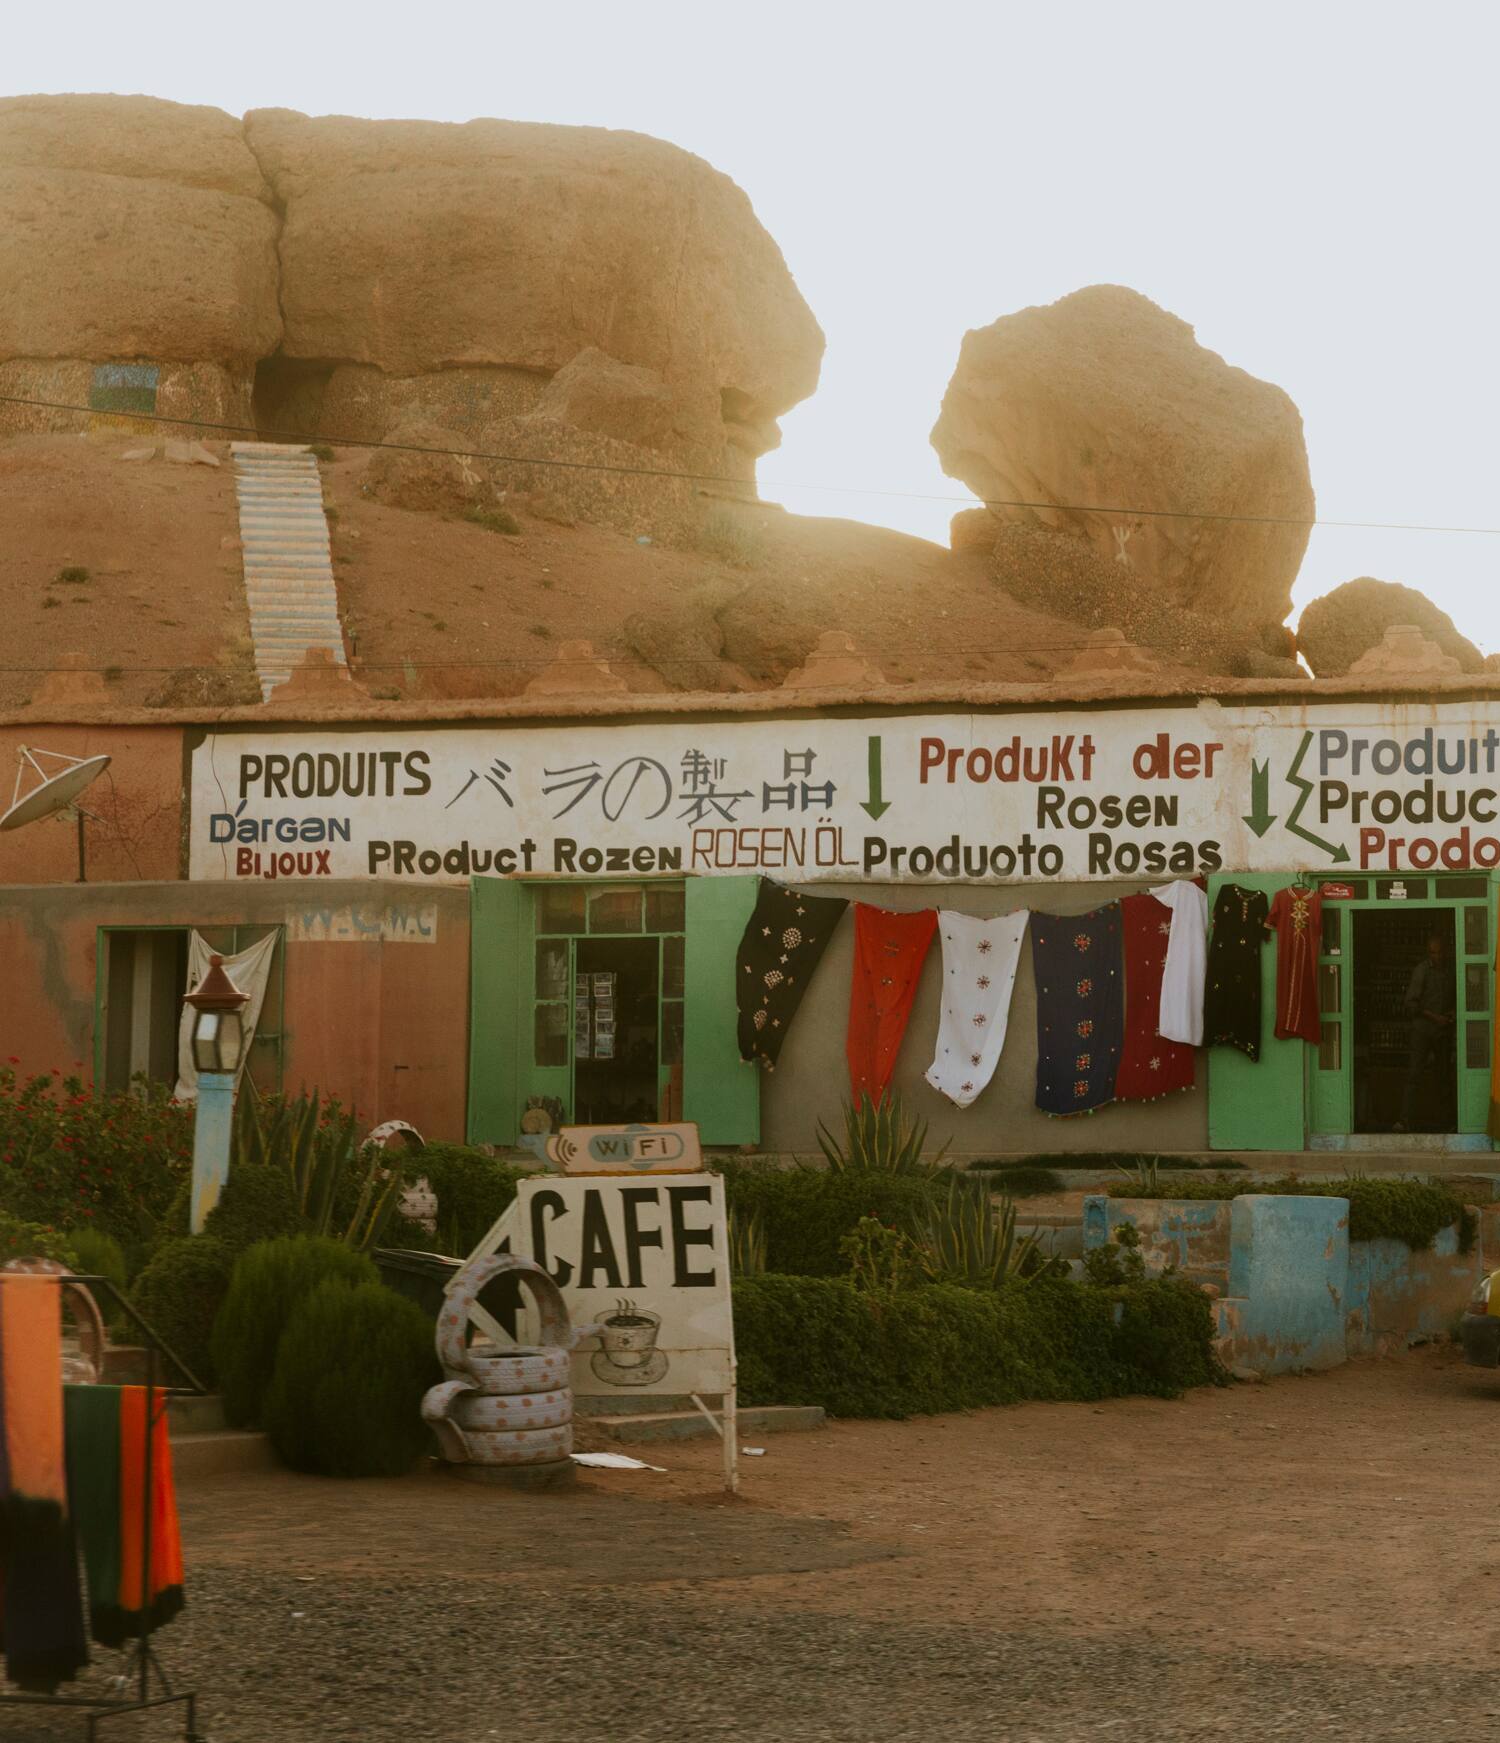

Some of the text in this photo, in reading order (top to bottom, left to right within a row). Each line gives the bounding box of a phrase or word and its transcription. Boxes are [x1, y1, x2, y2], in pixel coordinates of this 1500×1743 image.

[239, 750, 431, 798] PRODUITS
[1132, 733, 1224, 780] der
[1319, 727, 1500, 776] Produit
[445, 747, 838, 828] バラの製品
[691, 826, 806, 868] ROSEN
[1088, 832, 1223, 875] Rosas
[530, 1185, 717, 1289] CAFE
